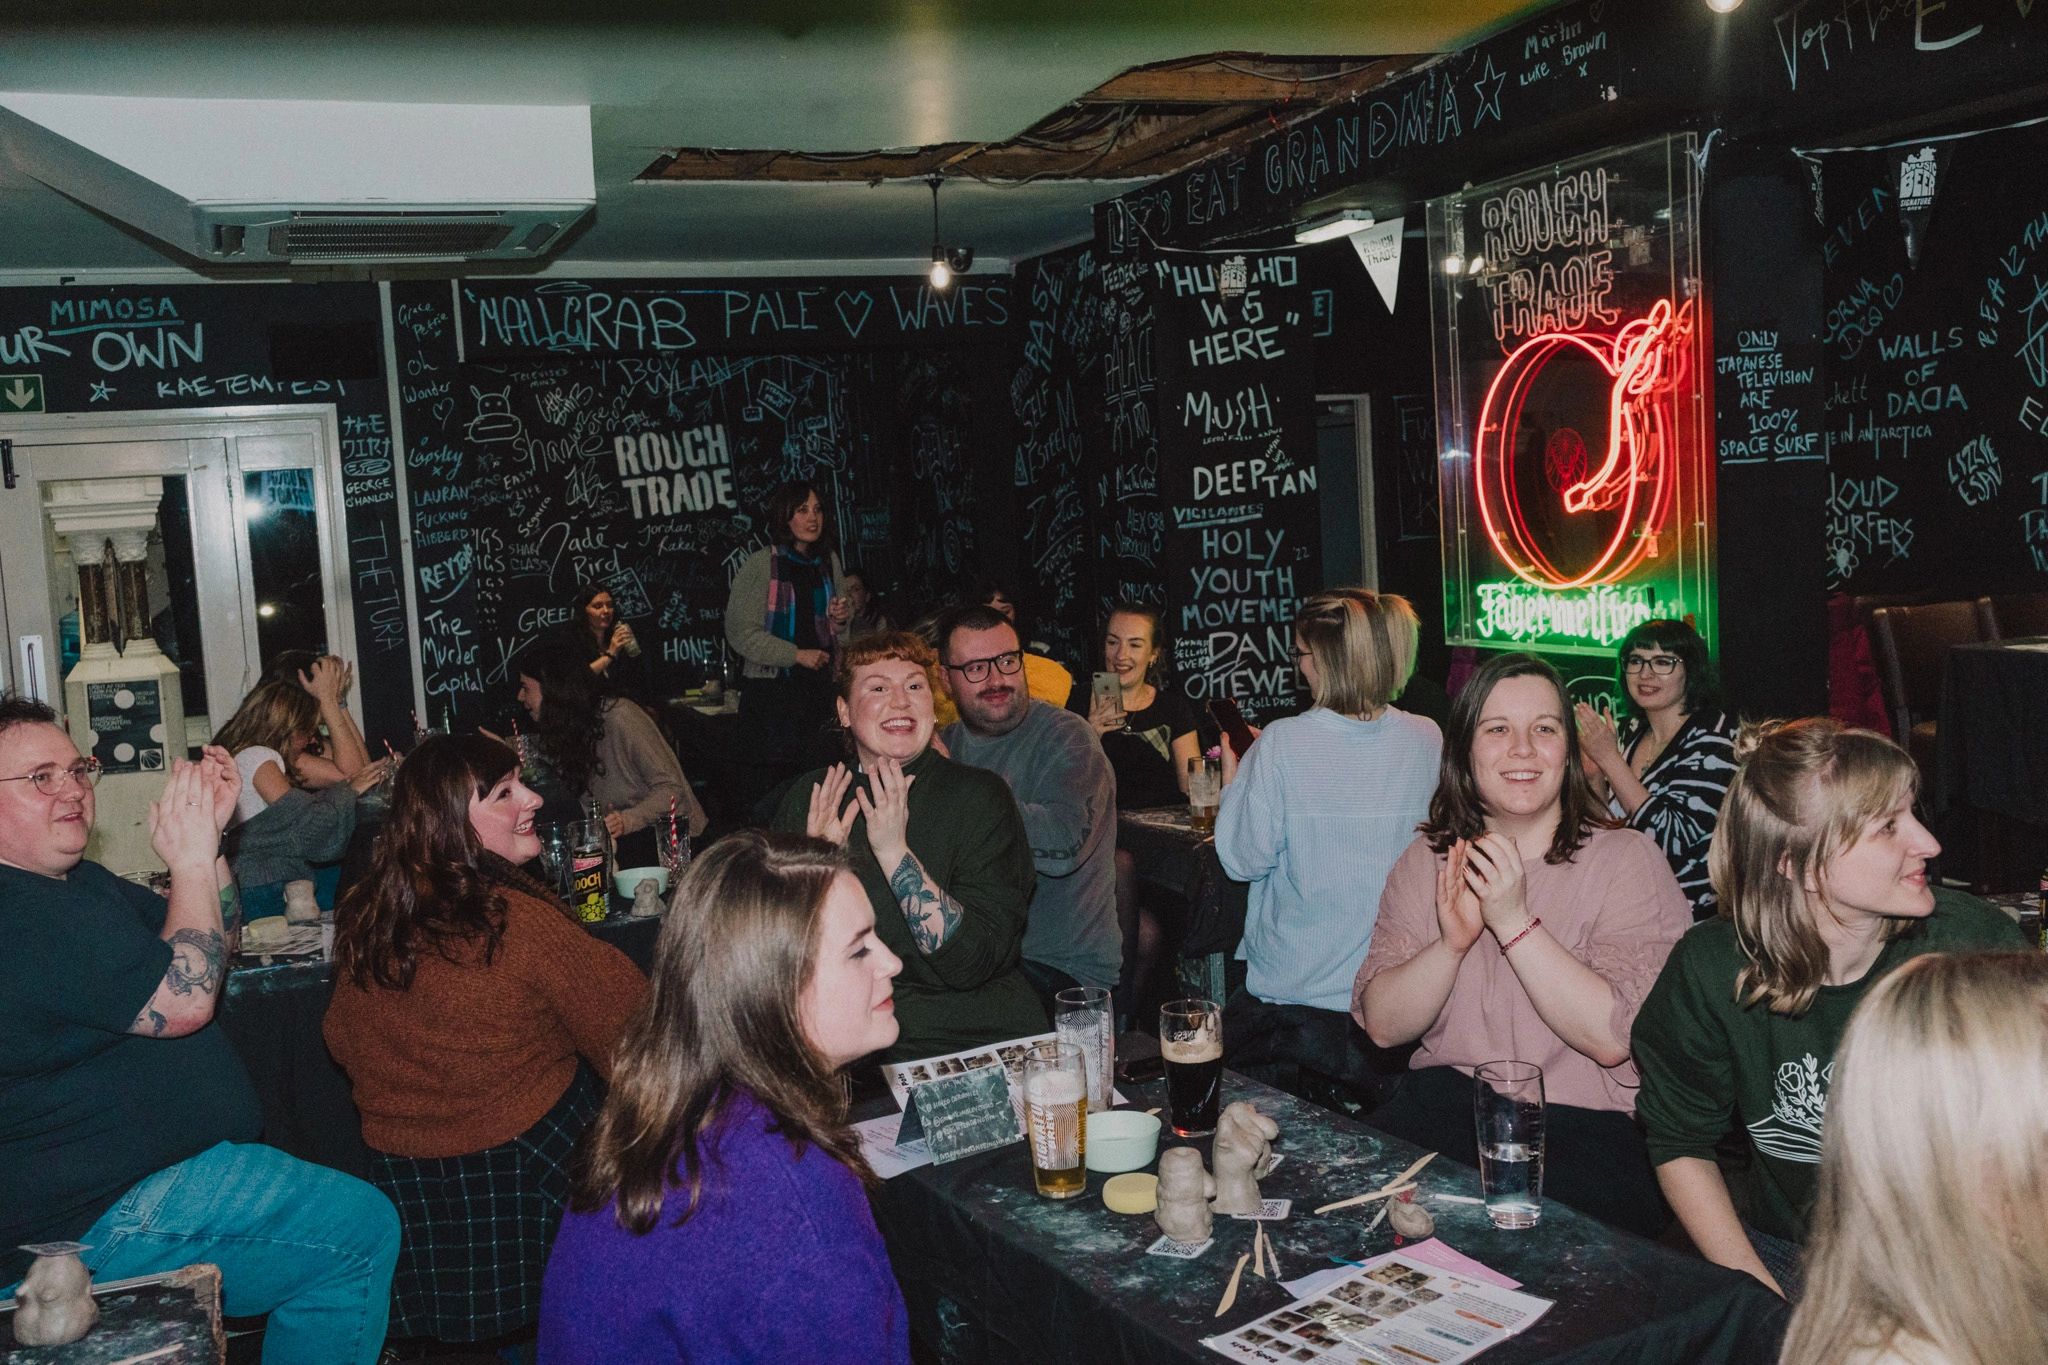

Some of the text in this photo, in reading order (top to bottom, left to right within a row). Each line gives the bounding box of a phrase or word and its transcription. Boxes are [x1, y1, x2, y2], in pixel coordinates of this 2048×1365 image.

[1562, 31, 1608, 68] Brown
[1186, 156, 1246, 225] EAT
[1263, 70, 1463, 195] GRANDMA
[1899, 168, 1936, 199] BEER
[1481, 167, 1609, 264] ROUGH
[1365, 247, 1399, 266] TRADE
[50, 296, 180, 325] MIMOSA
[724, 289, 820, 340] PALE
[890, 285, 1010, 332] WAVES
[1485, 249, 1619, 342] TRADE
[91, 321, 204, 373] OWN
[1737, 330, 1779, 349] ONLY
[1877, 326, 1965, 363] WALLS
[1716, 353, 1784, 375] JAPANESE
[1736, 366, 1815, 390] TELEVISION
[1904, 360, 1938, 387] OF
[156, 376, 216, 398] KAE
[1740, 389, 1774, 410] ARE
[1887, 383, 1969, 418] DADA
[1183, 383, 1274, 437] MUSH
[1747, 408, 1799, 434] 100%
[613, 422, 730, 477] ROUGH
[1719, 431, 1819, 458] SPACE SURF
[345, 477, 392, 497] GEORGE
[621, 467, 738, 520] TRADE
[1192, 458, 1267, 502] DEEP
[1261, 464, 1318, 499] TAN
[1825, 471, 1900, 516] LOUD
[415, 508, 469, 529] FUCKING
[1201, 527, 1285, 570] HOLY
[1189, 564, 1296, 601] YOUTH
[423, 608, 472, 637] The
[422, 635, 479, 669] Murder
[1207, 624, 1292, 666] DAN
[425, 667, 484, 714] Capital
